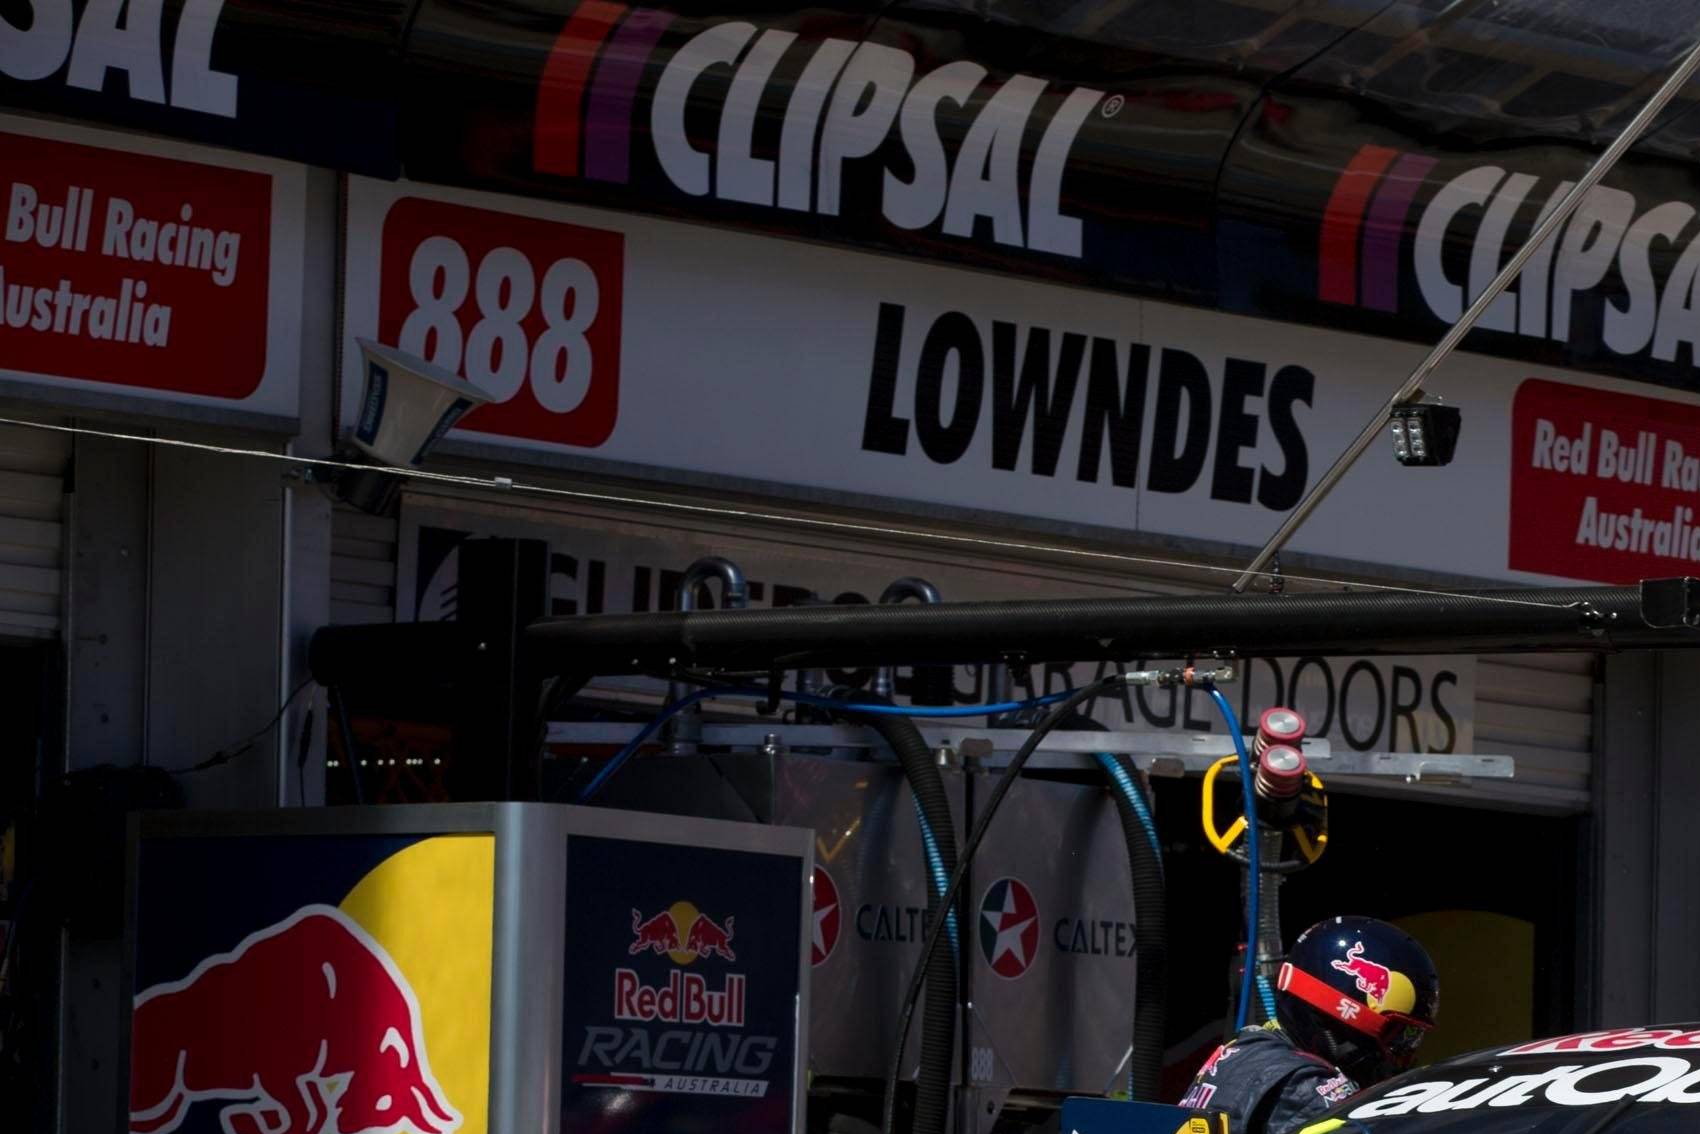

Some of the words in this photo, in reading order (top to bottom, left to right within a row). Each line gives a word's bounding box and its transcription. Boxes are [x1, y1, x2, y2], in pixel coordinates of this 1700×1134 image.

[650, 21, 1107, 259] CLIPSAL
[5, 183, 93, 253] Bull
[102, 196, 241, 287] Racing
[0, 267, 172, 348] ustralia
[397, 236, 600, 414] 888
[862, 302, 1315, 512] LOWNDES
[1532, 418, 1592, 473] Red
[1597, 425, 1655, 484] Bull
[1243, 656, 1458, 756] DOORS
[856, 904, 928, 942] CALT
[614, 967, 682, 1022] Red
[682, 972, 746, 1028] Bull
[577, 1025, 779, 1075] RACING
[663, 1080, 761, 1095] AUSTRALIA
